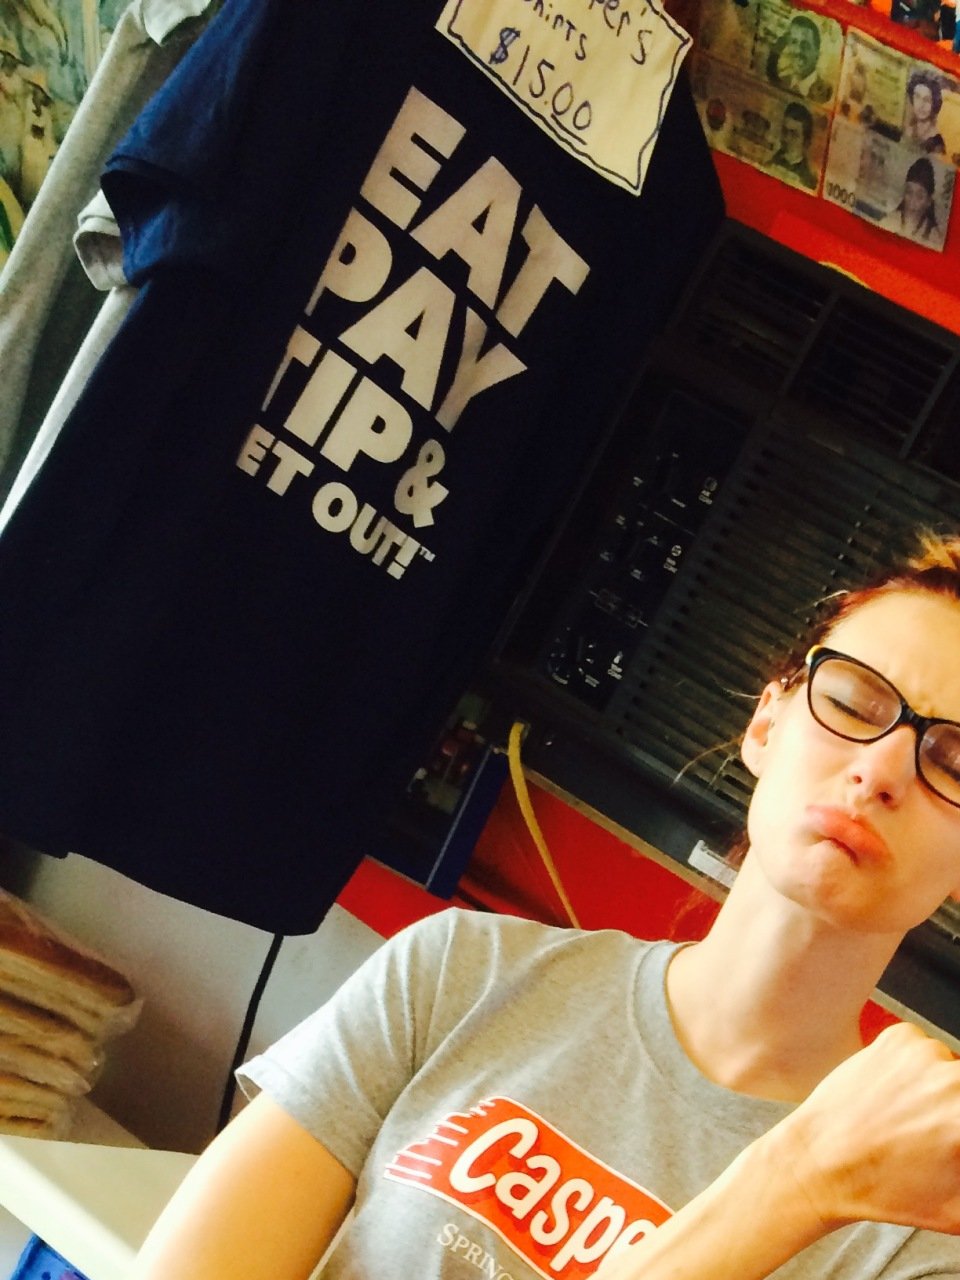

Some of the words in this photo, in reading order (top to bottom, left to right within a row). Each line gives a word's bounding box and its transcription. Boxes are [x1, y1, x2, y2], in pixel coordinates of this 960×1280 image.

[488, 26, 593, 131] $15.00
[359, 85, 591, 339] EAT
[261, 324, 414, 472] TIP
[393, 438, 450, 529] &
[304, 207, 528, 433] PAY
